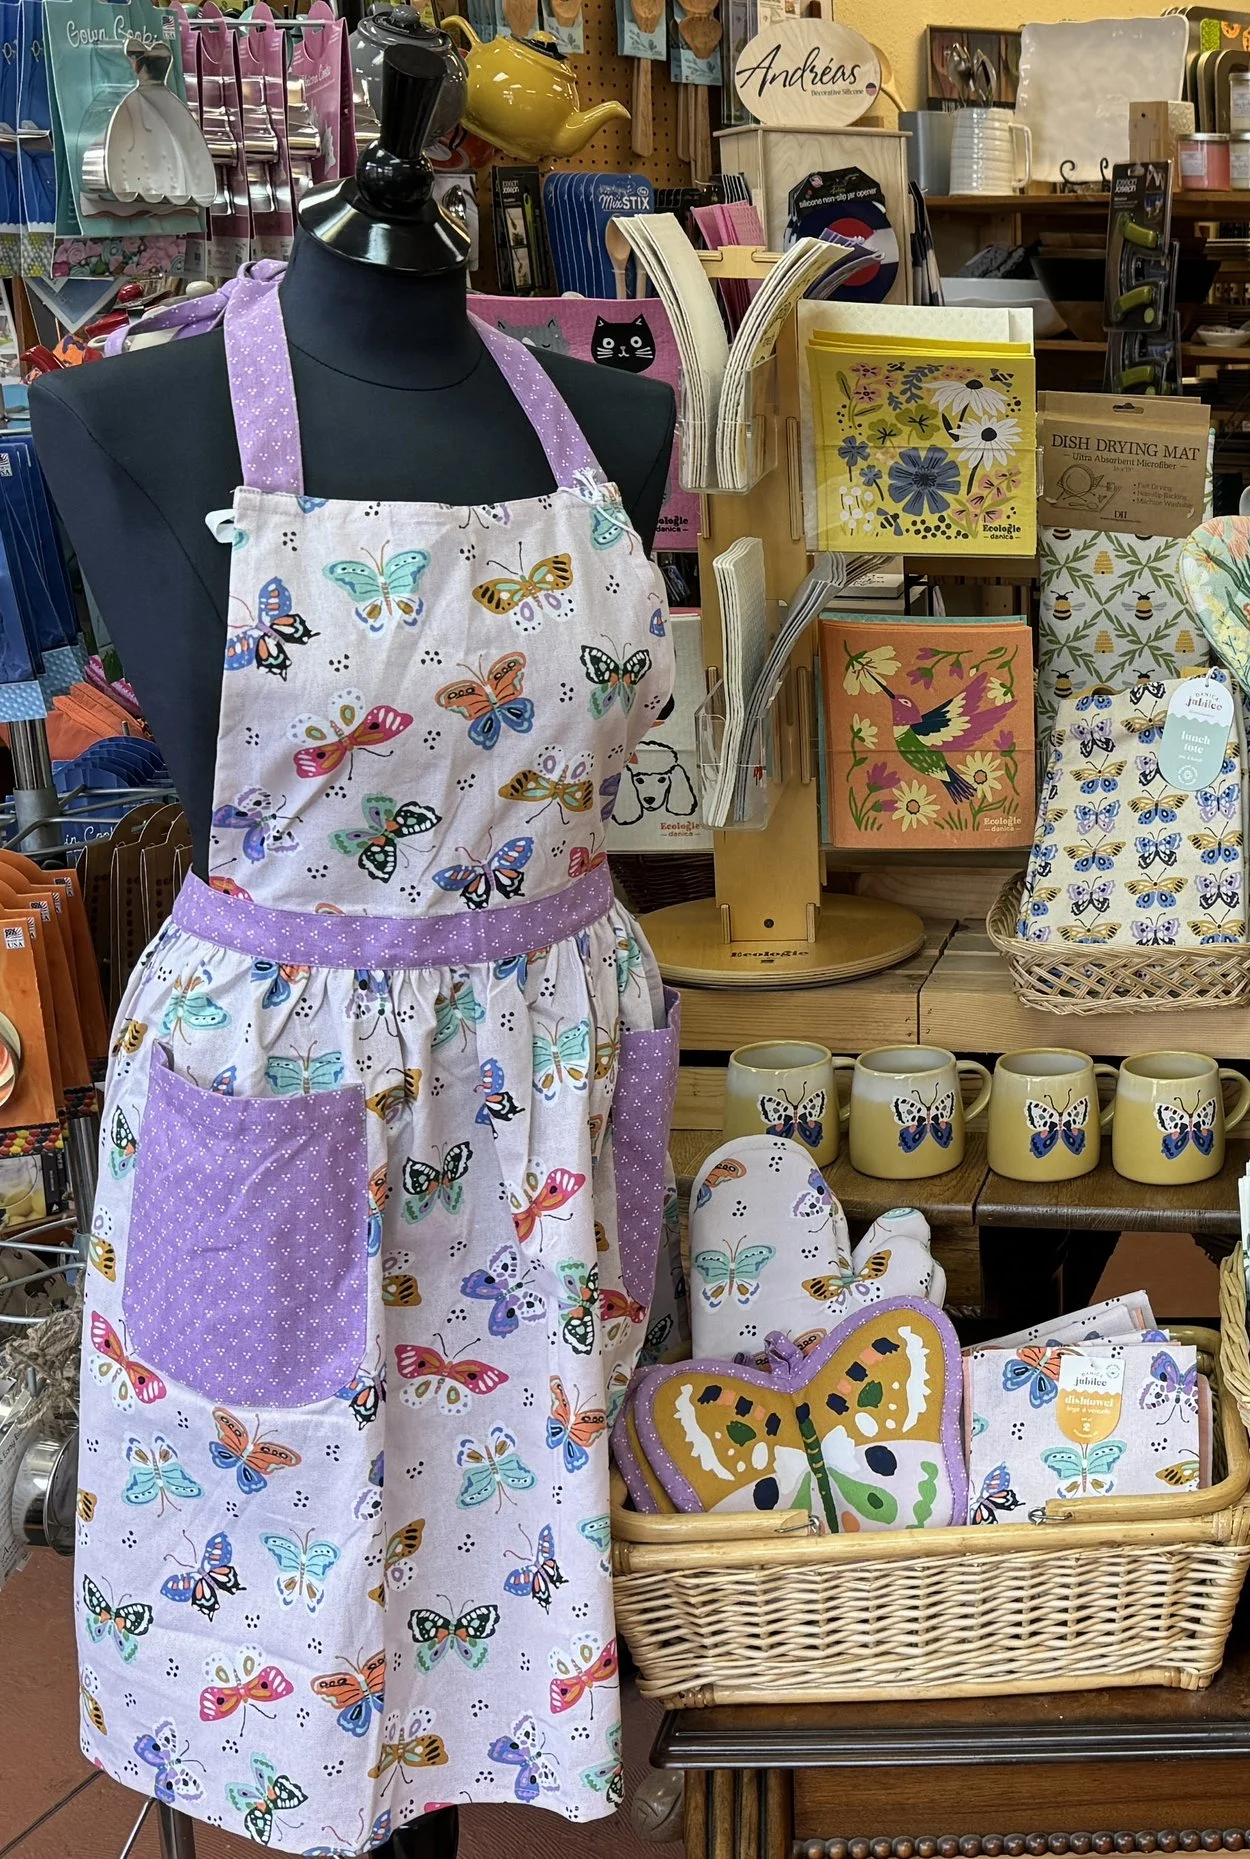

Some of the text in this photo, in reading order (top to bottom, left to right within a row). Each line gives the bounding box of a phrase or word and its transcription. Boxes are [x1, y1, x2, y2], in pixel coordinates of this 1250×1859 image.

[66, 20, 107, 48] Gown
[736, 44, 861, 97] Andréas
[856, 187, 877, 197] opener
[1052, 434, 1200, 461] DISH DRYING MAT
[1072, 453, 1092, 462] Ultra
[1094, 455, 1135, 466] Absorbent
[1136, 459, 1177, 470] Microfiber
[658, 515, 688, 526] ologie
[983, 523, 1021, 534] Ecologie
[1185, 696, 1223, 711] jubilee
[1181, 730, 1211, 745] lunch
[1183, 743, 1204, 754] tote
[660, 821, 700, 831] Ecologie
[984, 815, 1022, 827] Ecologie
[1075, 1377, 1107, 1386] jubilee
[1065, 1394, 1114, 1407] dishtowel
